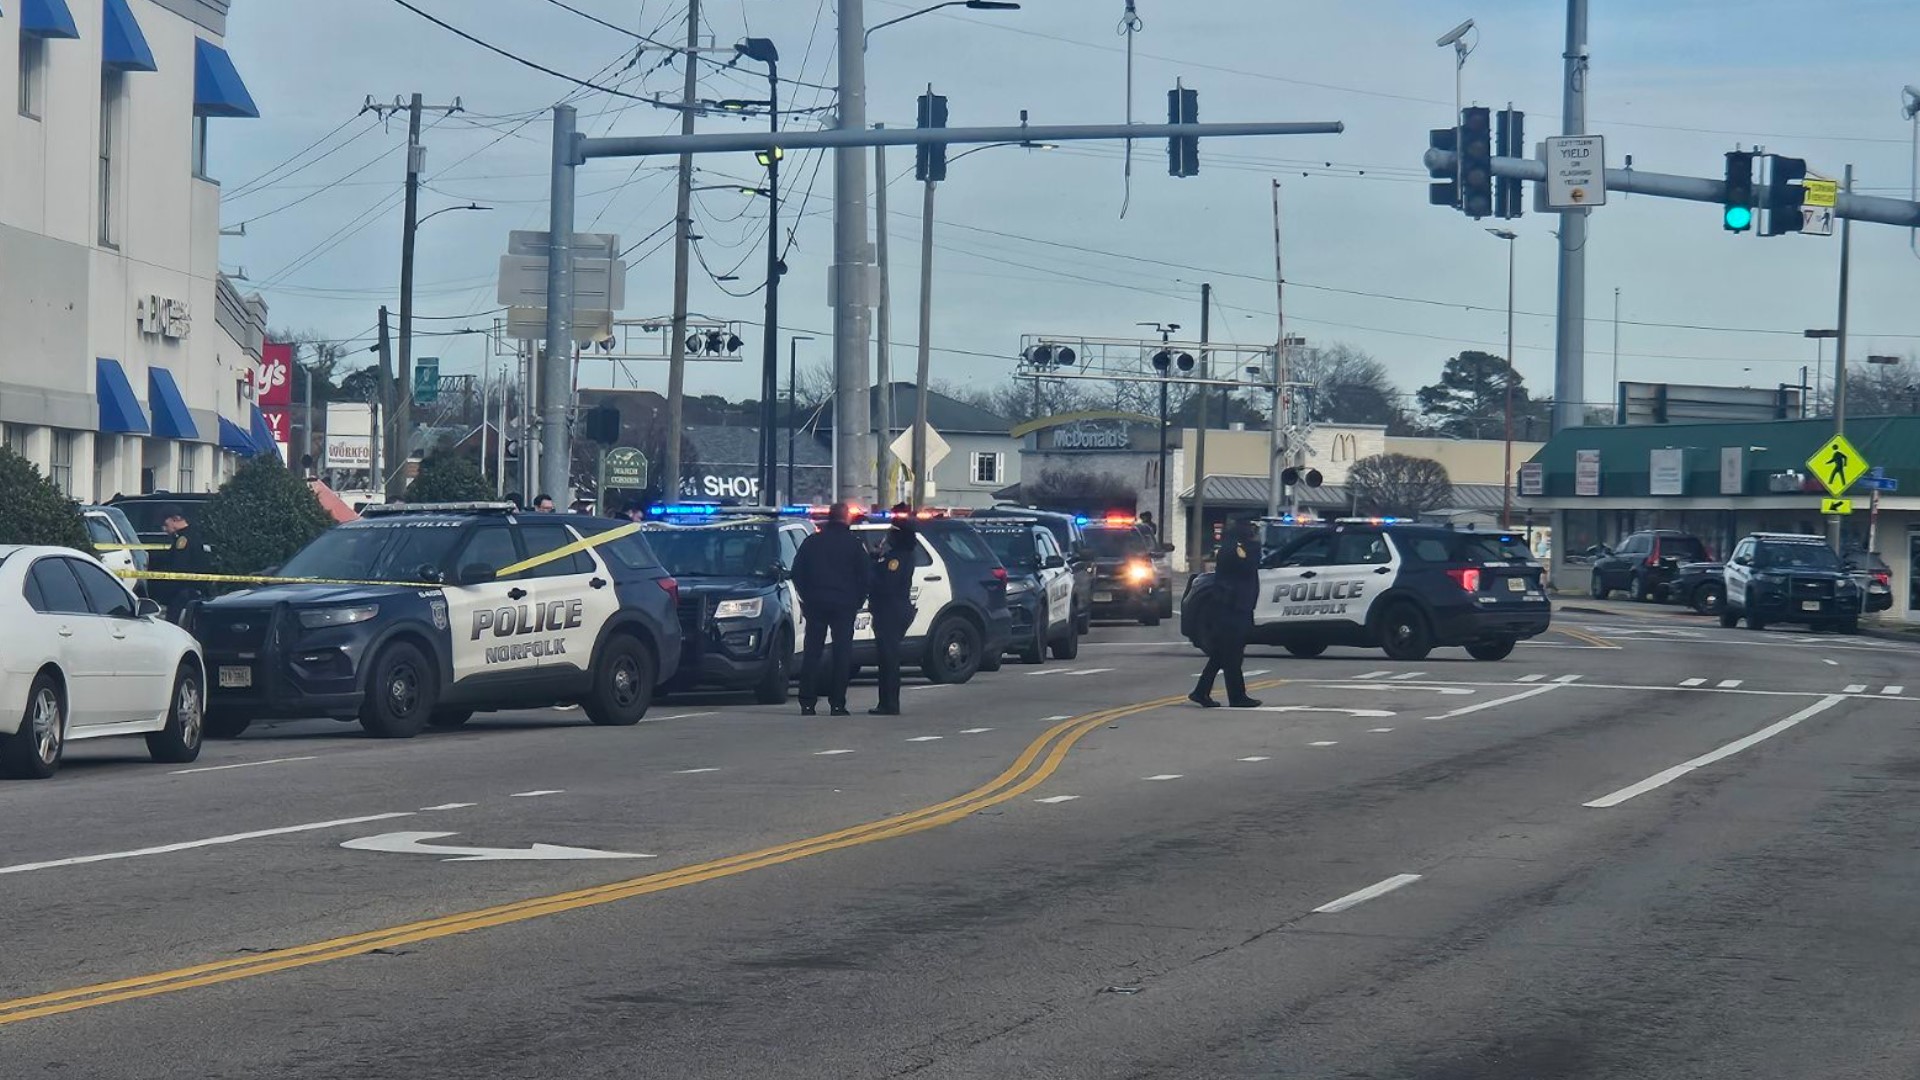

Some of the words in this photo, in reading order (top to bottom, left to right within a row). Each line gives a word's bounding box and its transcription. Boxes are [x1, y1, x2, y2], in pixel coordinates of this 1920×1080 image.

[1560, 149, 1590, 158] YIELD
[1053, 429, 1129, 448] McDonald's
[1272, 580, 1365, 603] POLICE
[471, 598, 583, 641] POLICE
[1281, 603, 1348, 617] NORFOLK
[485, 637, 567, 664] NORFOLK
